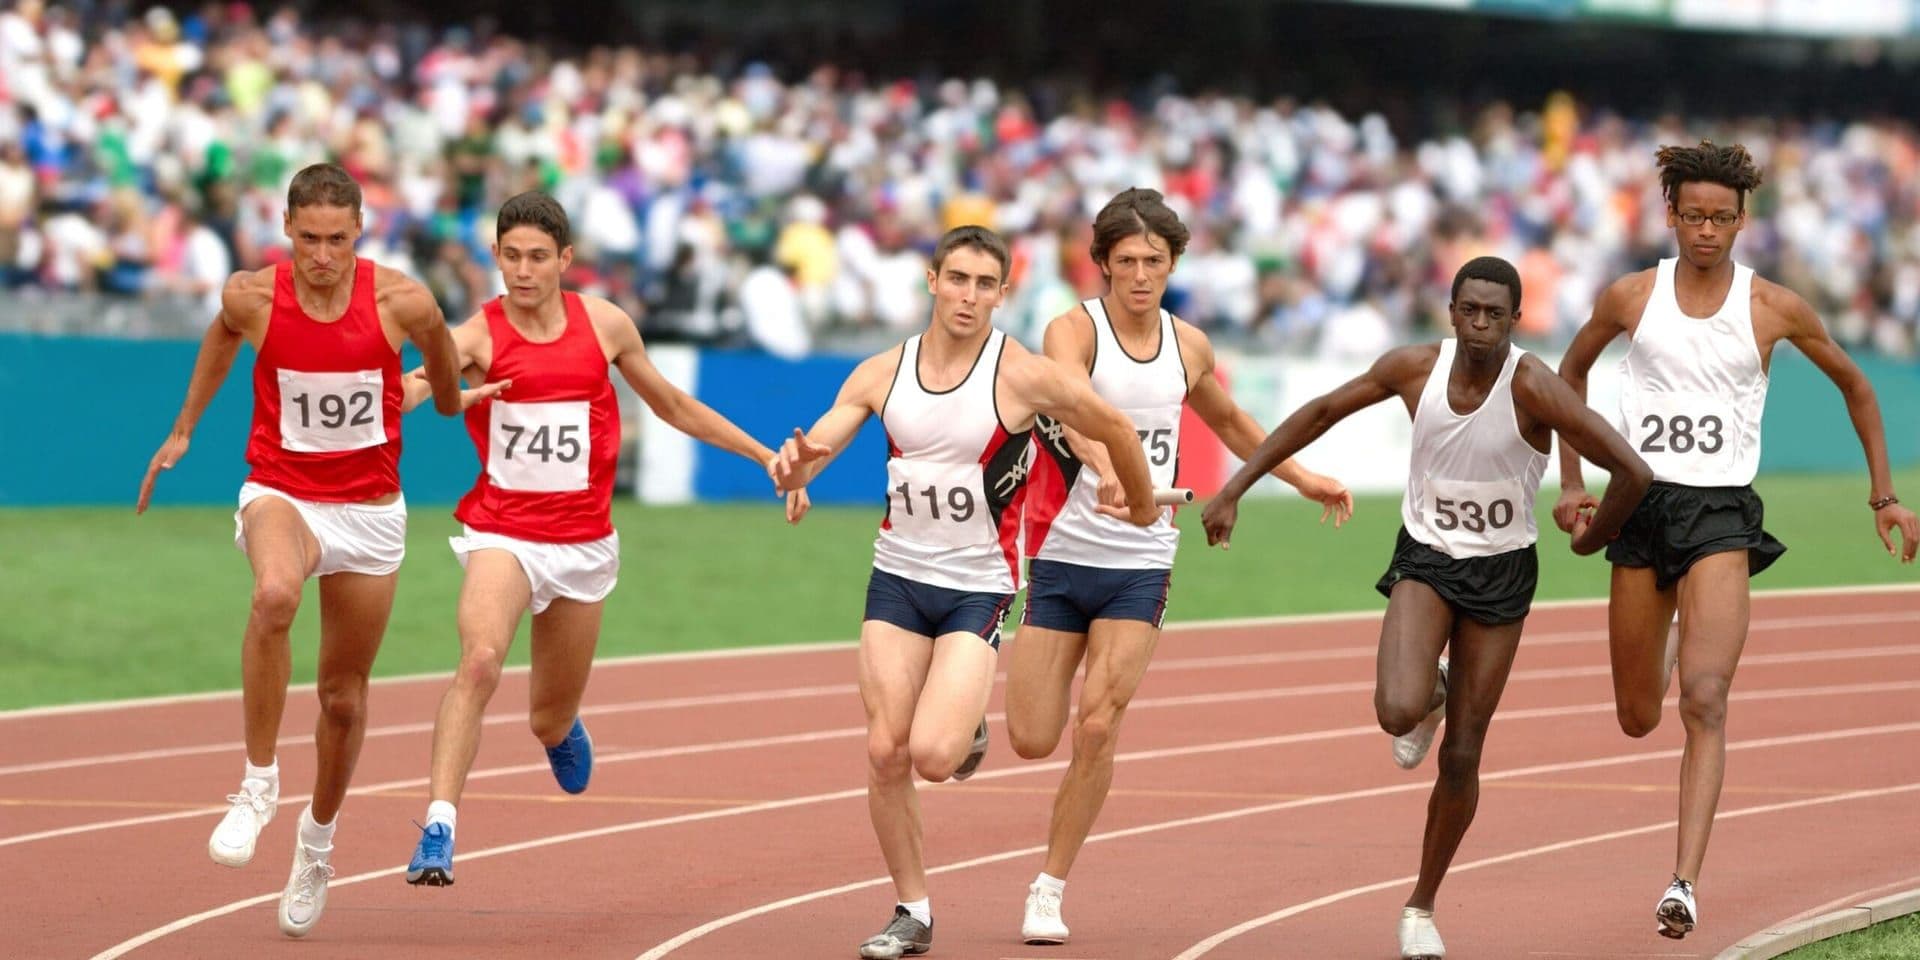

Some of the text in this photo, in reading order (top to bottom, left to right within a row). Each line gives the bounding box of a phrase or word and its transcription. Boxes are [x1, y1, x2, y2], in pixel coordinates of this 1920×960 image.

[292, 390, 375, 429] 192
[501, 423, 581, 463] 745
[1640, 414, 1724, 454] 283
[896, 481, 975, 522] 119
[1435, 497, 1514, 533] 530
